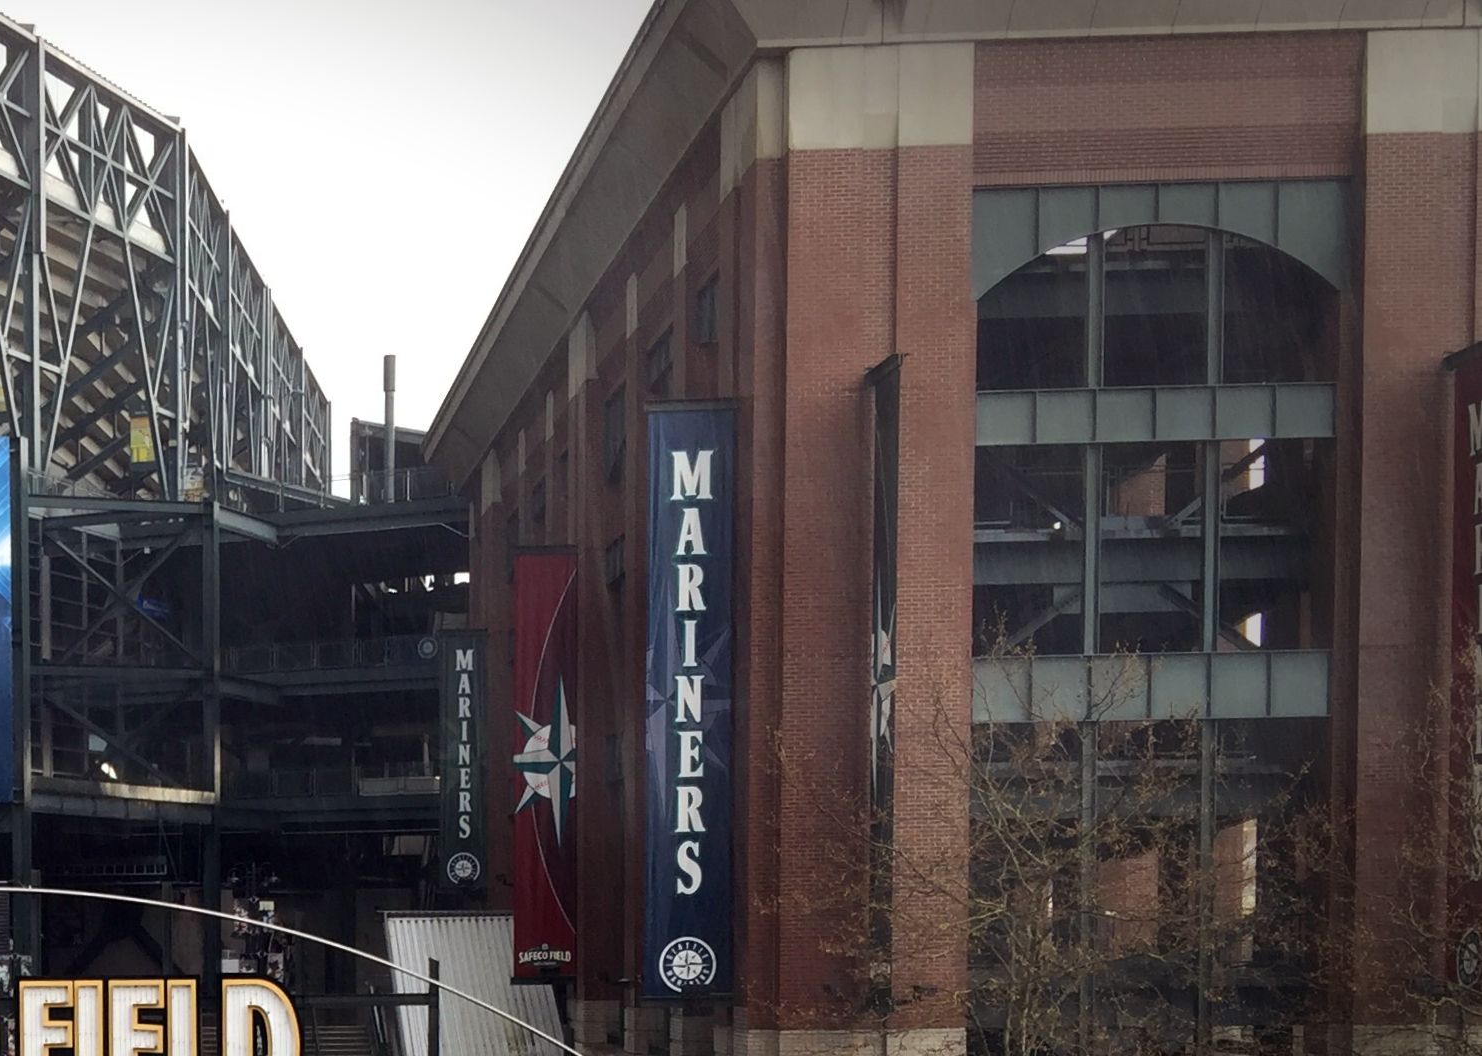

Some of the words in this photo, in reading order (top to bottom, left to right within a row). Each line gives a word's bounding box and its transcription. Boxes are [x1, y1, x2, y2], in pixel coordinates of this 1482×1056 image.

[455, 648, 474, 839] MARINERS
[670, 449, 714, 896] MARINERS
[518, 951, 548, 964] SAFECO
[549, 950, 572, 963] FIELD
